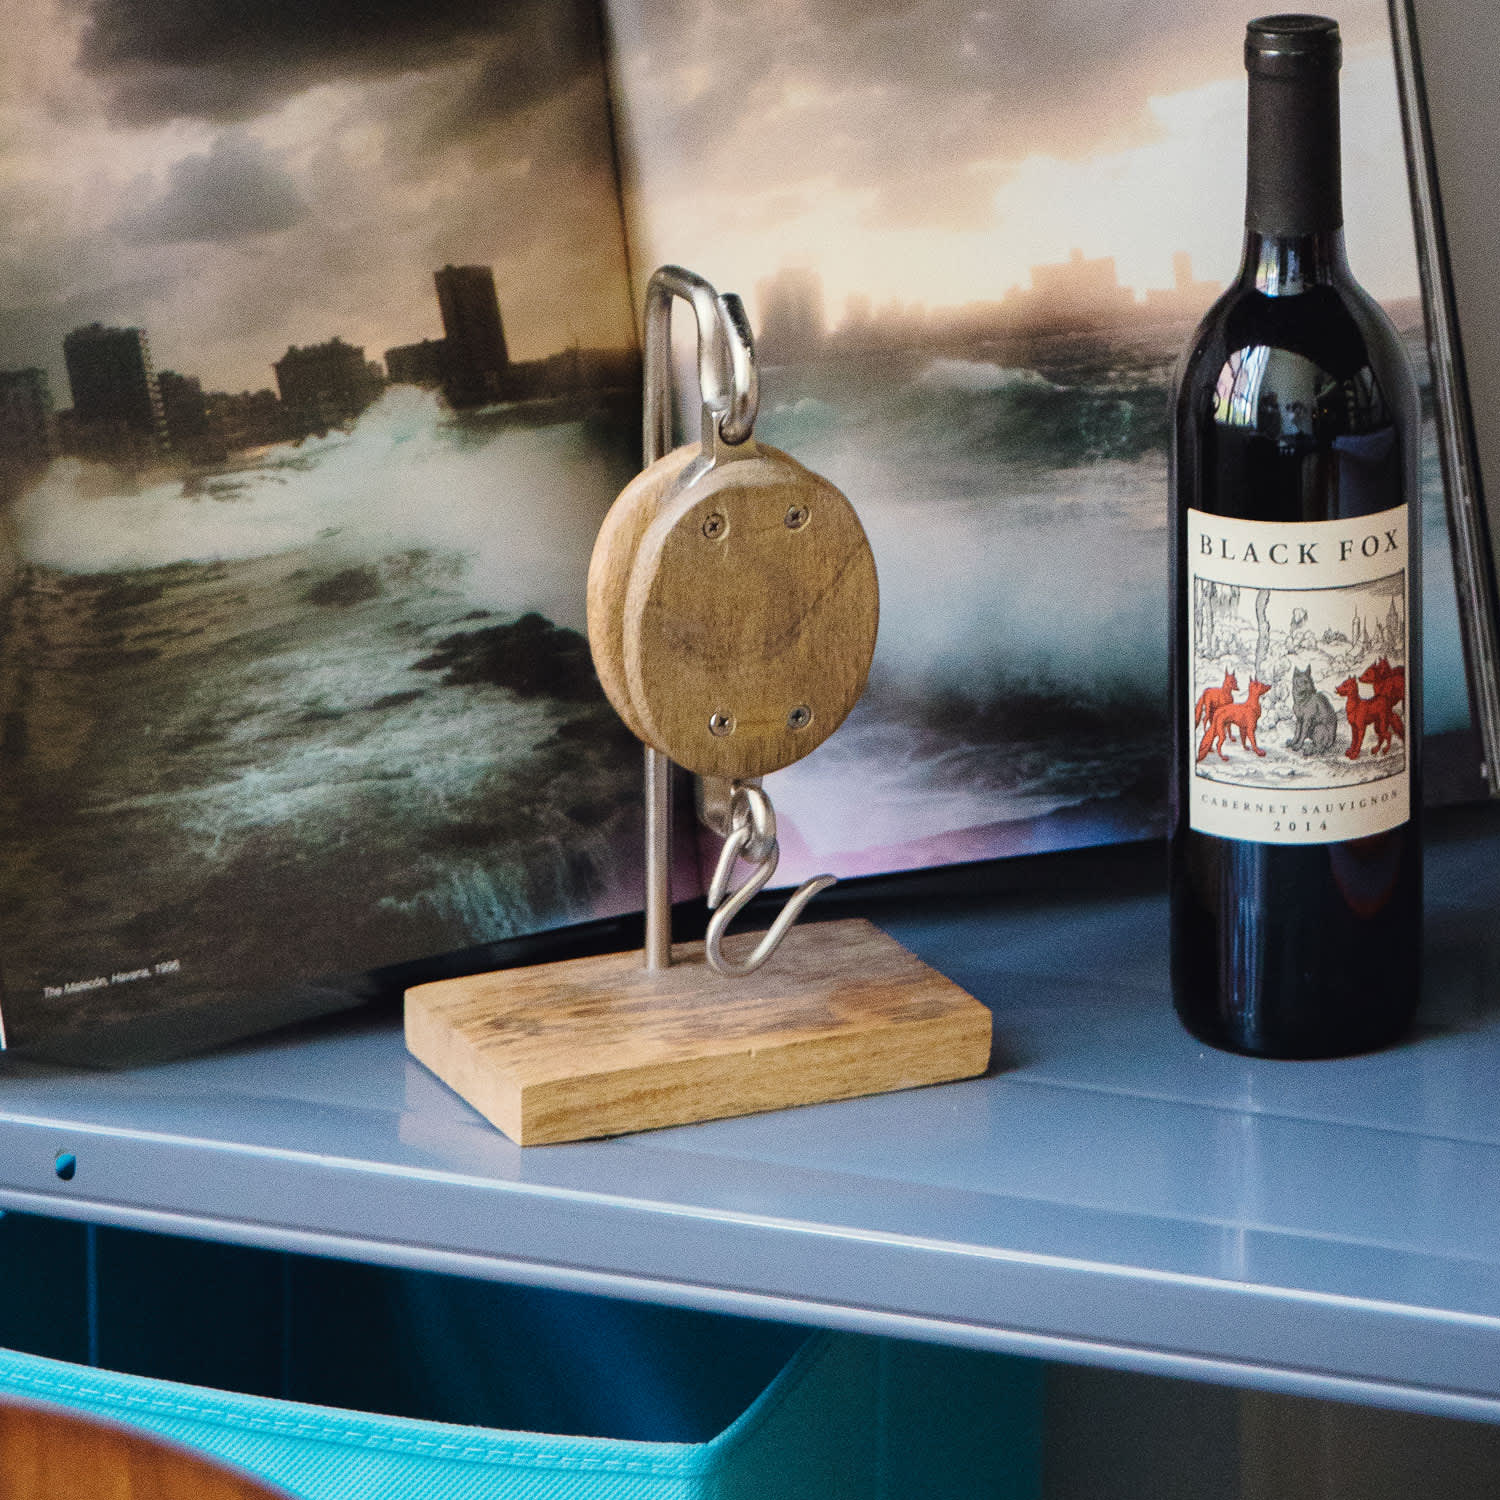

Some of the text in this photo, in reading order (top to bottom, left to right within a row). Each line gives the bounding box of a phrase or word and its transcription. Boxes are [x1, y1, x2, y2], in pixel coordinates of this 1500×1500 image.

[1200, 528, 1400, 565] BLACK FOX
[1200, 789, 1400, 815] CABERNET SAUVIGNON
[1273, 820, 1329, 832] 2014
